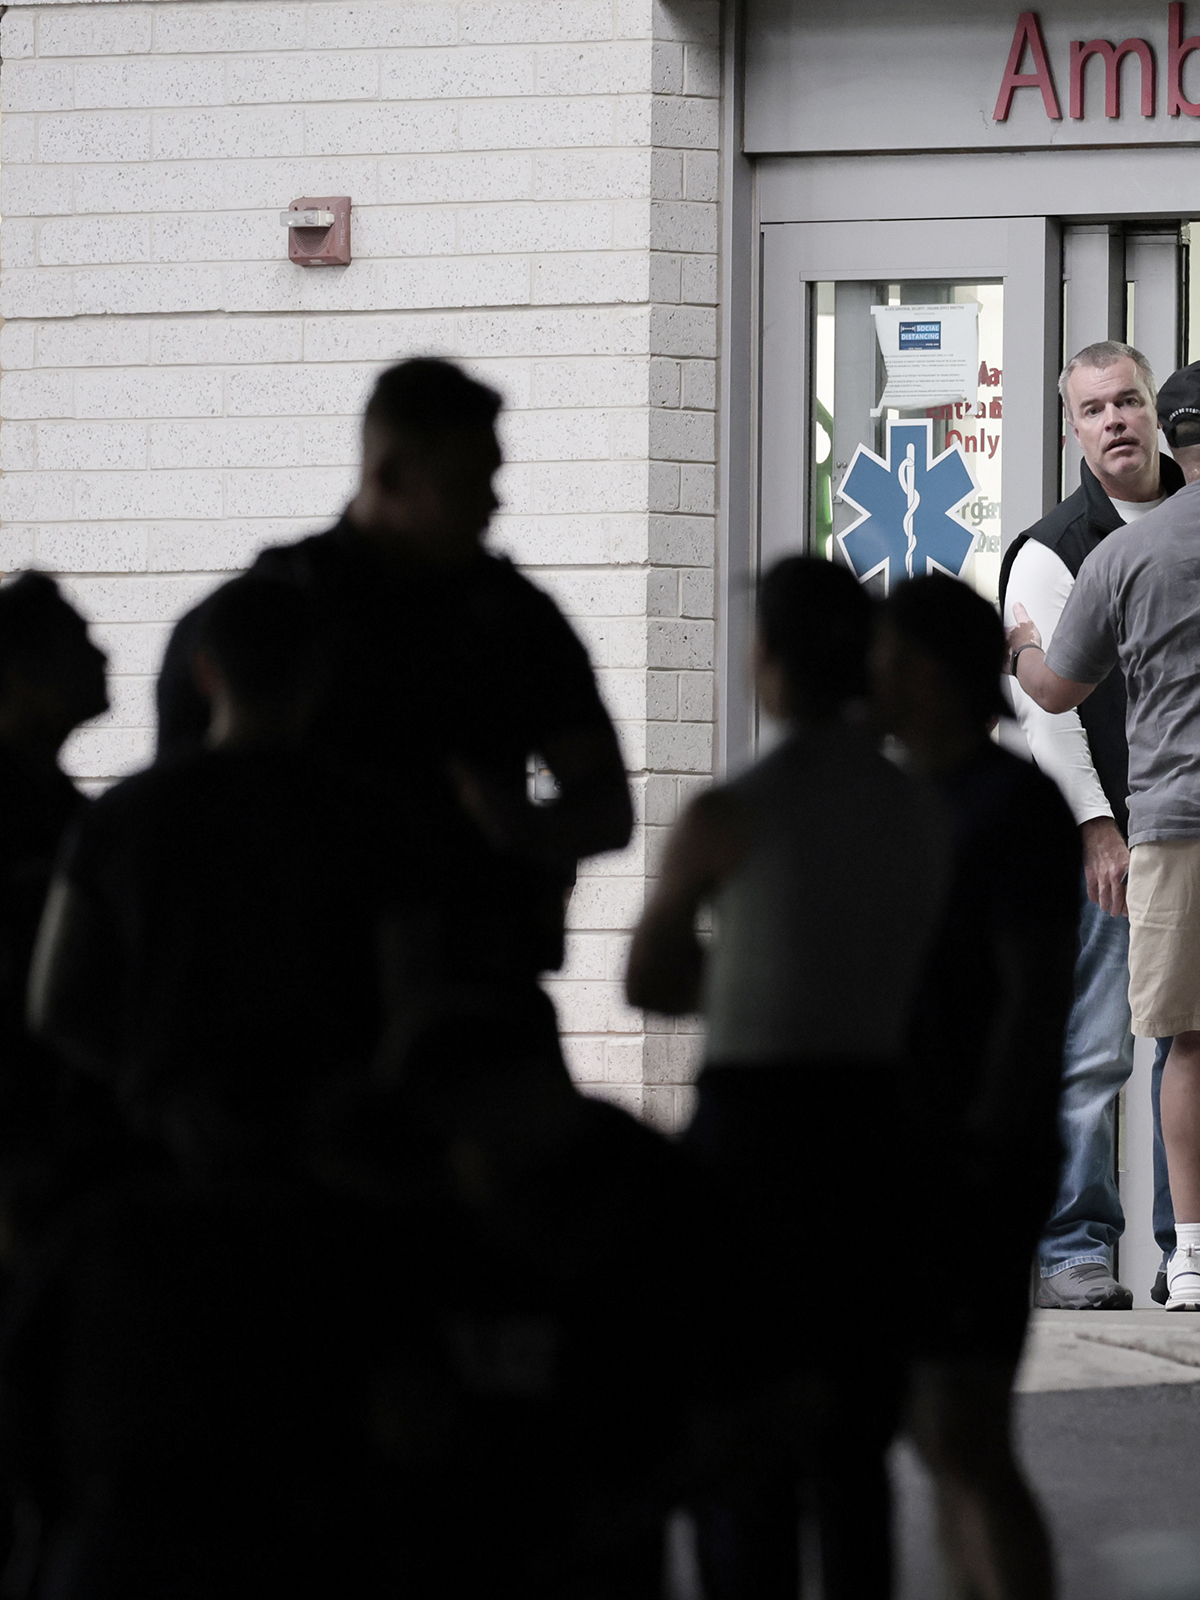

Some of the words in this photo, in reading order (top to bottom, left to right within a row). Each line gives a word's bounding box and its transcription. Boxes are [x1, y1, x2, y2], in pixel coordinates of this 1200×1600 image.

[917, 324, 940, 332] SOCIAL
[901, 332, 940, 341] DISTANCING
[945, 427, 1000, 460] Only
